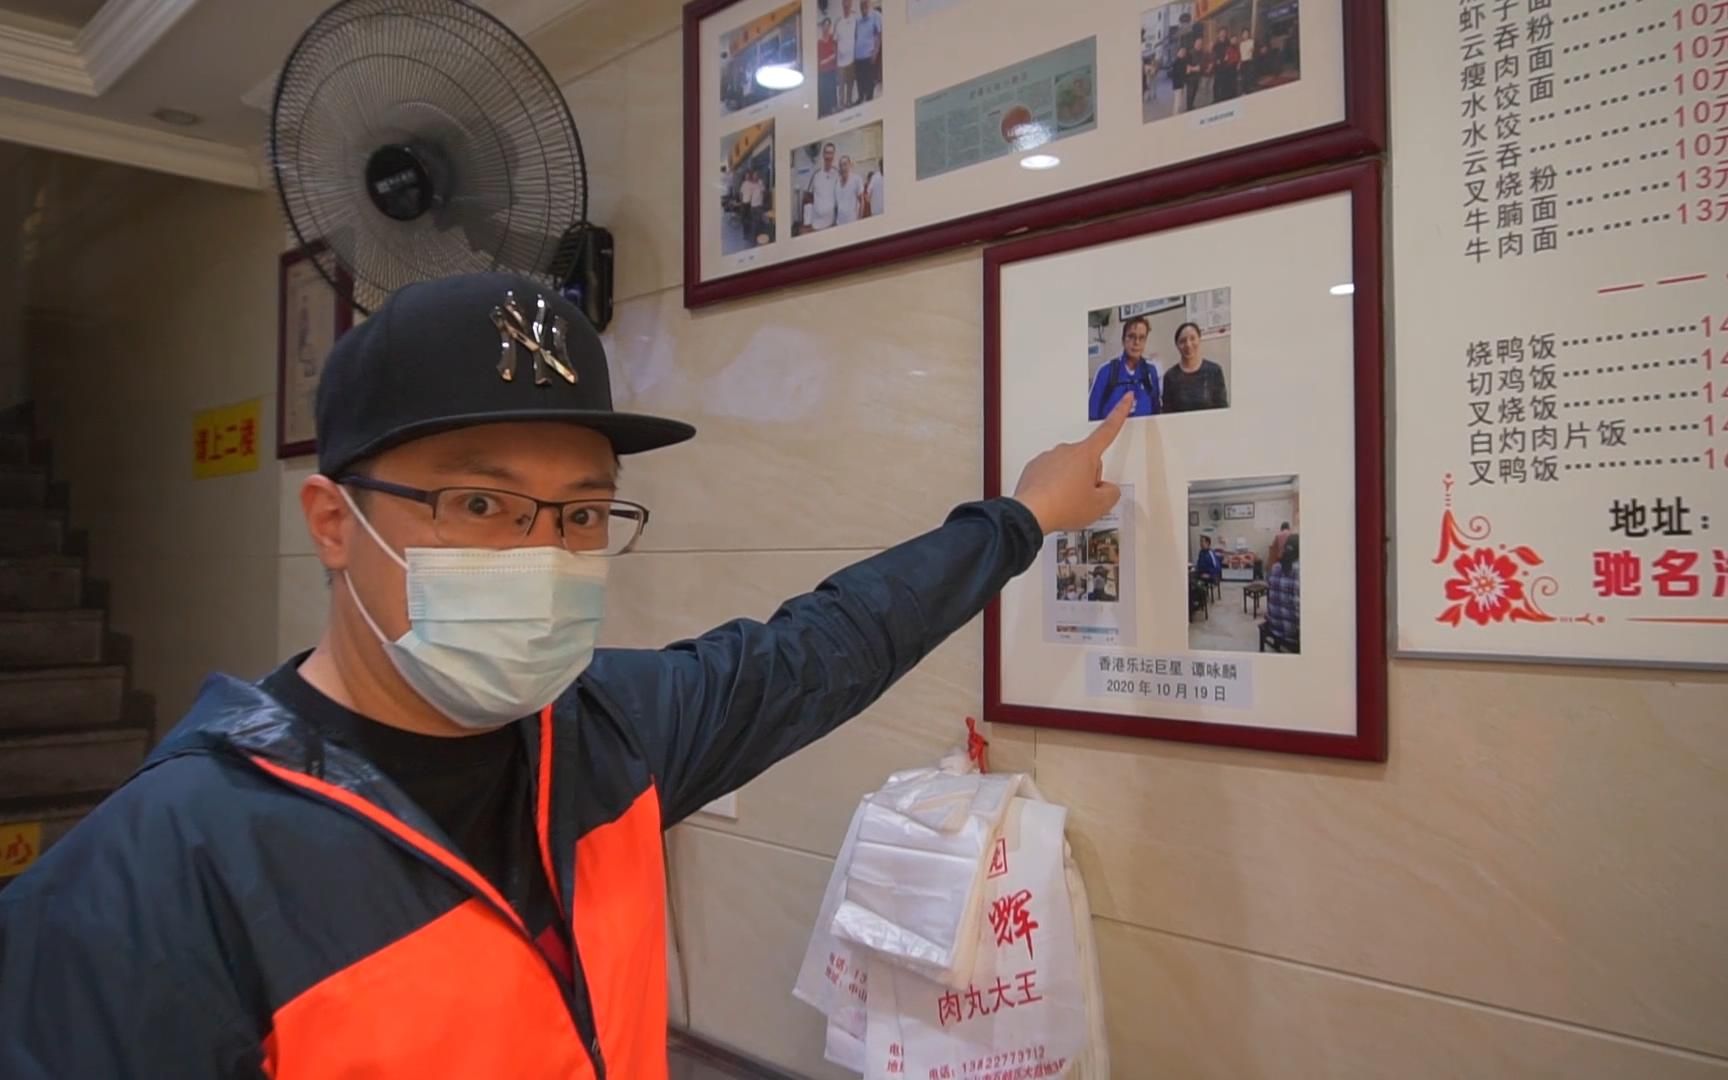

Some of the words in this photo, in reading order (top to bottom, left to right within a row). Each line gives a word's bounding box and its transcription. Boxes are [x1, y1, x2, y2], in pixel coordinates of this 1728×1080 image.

[1461, 14, 1553, 61] 云吞粉
[1461, 43, 1553, 91] 瘦肉面
[1462, 73, 1554, 119] 水饺面
[1462, 112, 1521, 148] 水饺
[1462, 142, 1522, 178] 云吞
[1463, 165, 1557, 207] 叉烧粉
[1464, 194, 1558, 234] 牛腩面
[1464, 224, 1558, 263] 牛肉面
[488, 290, 577, 385] NY
[1466, 333, 1557, 368] 烧鸭饭
[1467, 364, 1558, 397] 切鸡饭
[1468, 395, 1559, 427] 叉烧饭
[1470, 419, 1628, 456] 白灼肉片饭
[1469, 456, 1560, 486] 叉鸭饭
[1099, 656, 1183, 675] 香港乐坛巨星
[1107, 679, 1134, 693] 2020
[1139, 681, 1152, 697] 年
[1157, 683, 1170, 697] 10
[1175, 683, 1187, 699] 月
[1194, 685, 1207, 699] 19
[1214, 686, 1226, 701] 日
[938, 970, 1042, 1026] 肉丸大王
